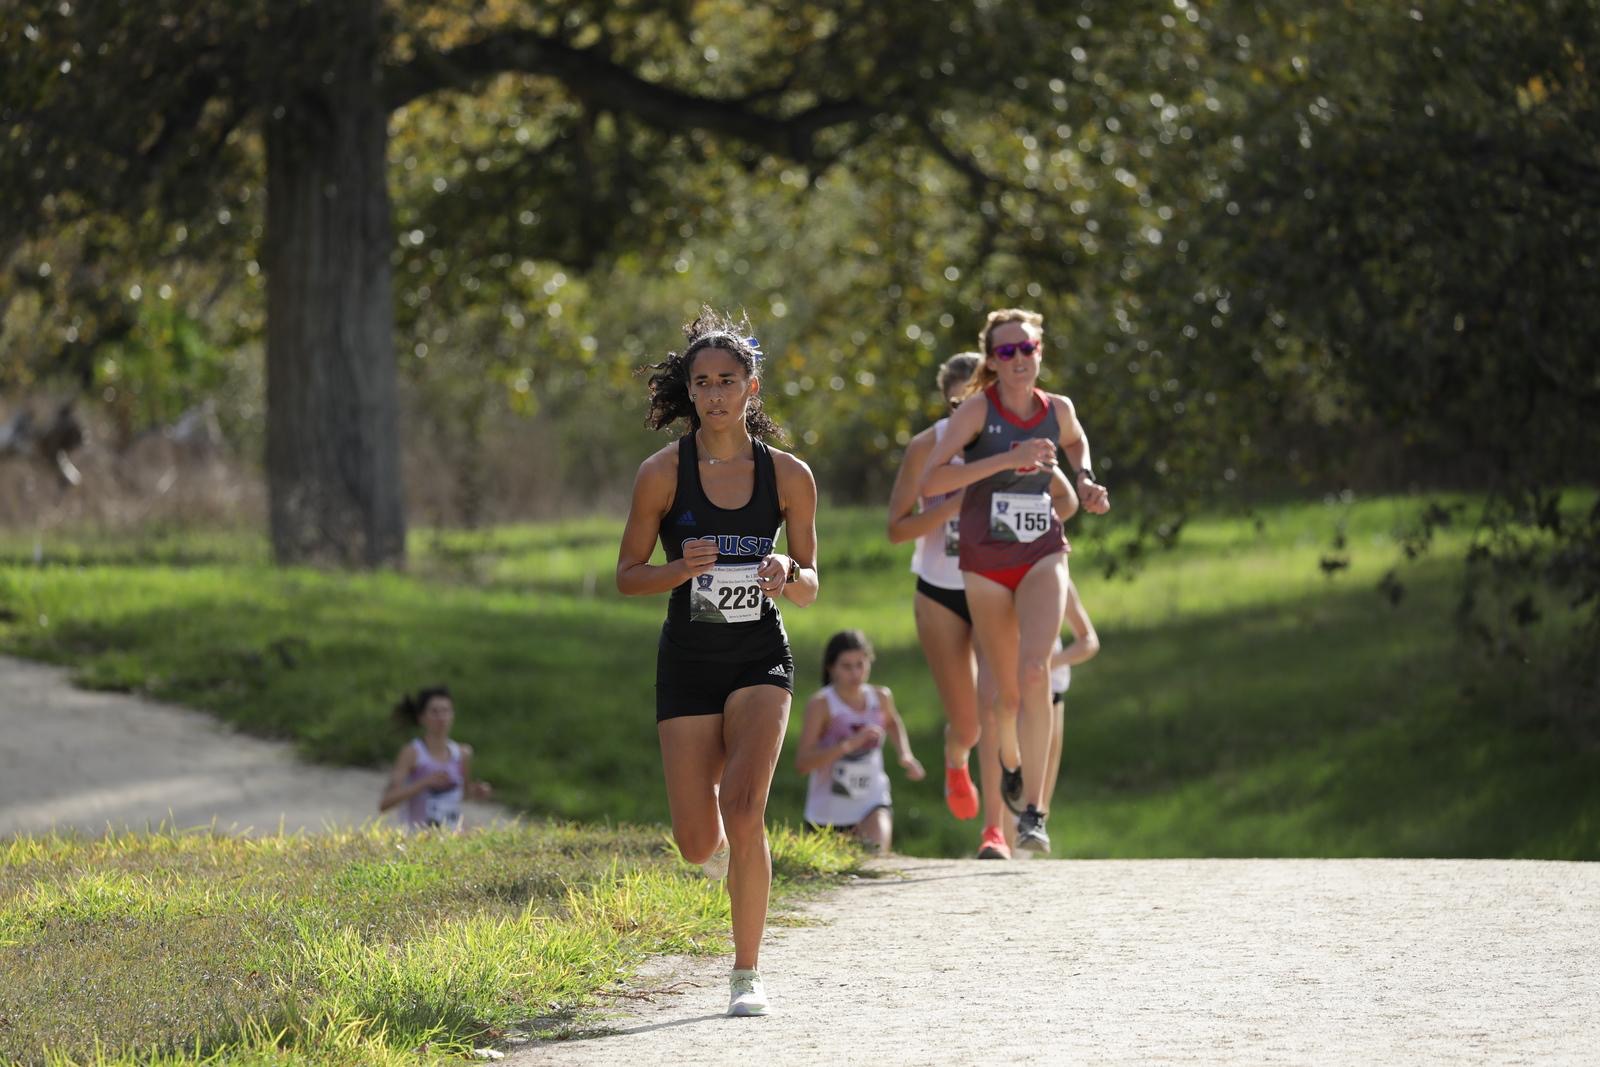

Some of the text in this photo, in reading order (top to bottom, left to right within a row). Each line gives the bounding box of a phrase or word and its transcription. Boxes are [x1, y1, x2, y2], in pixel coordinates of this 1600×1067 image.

[1014, 512, 1048, 532] 155
[681, 535, 774, 557] USB
[718, 584, 760, 610] 223
